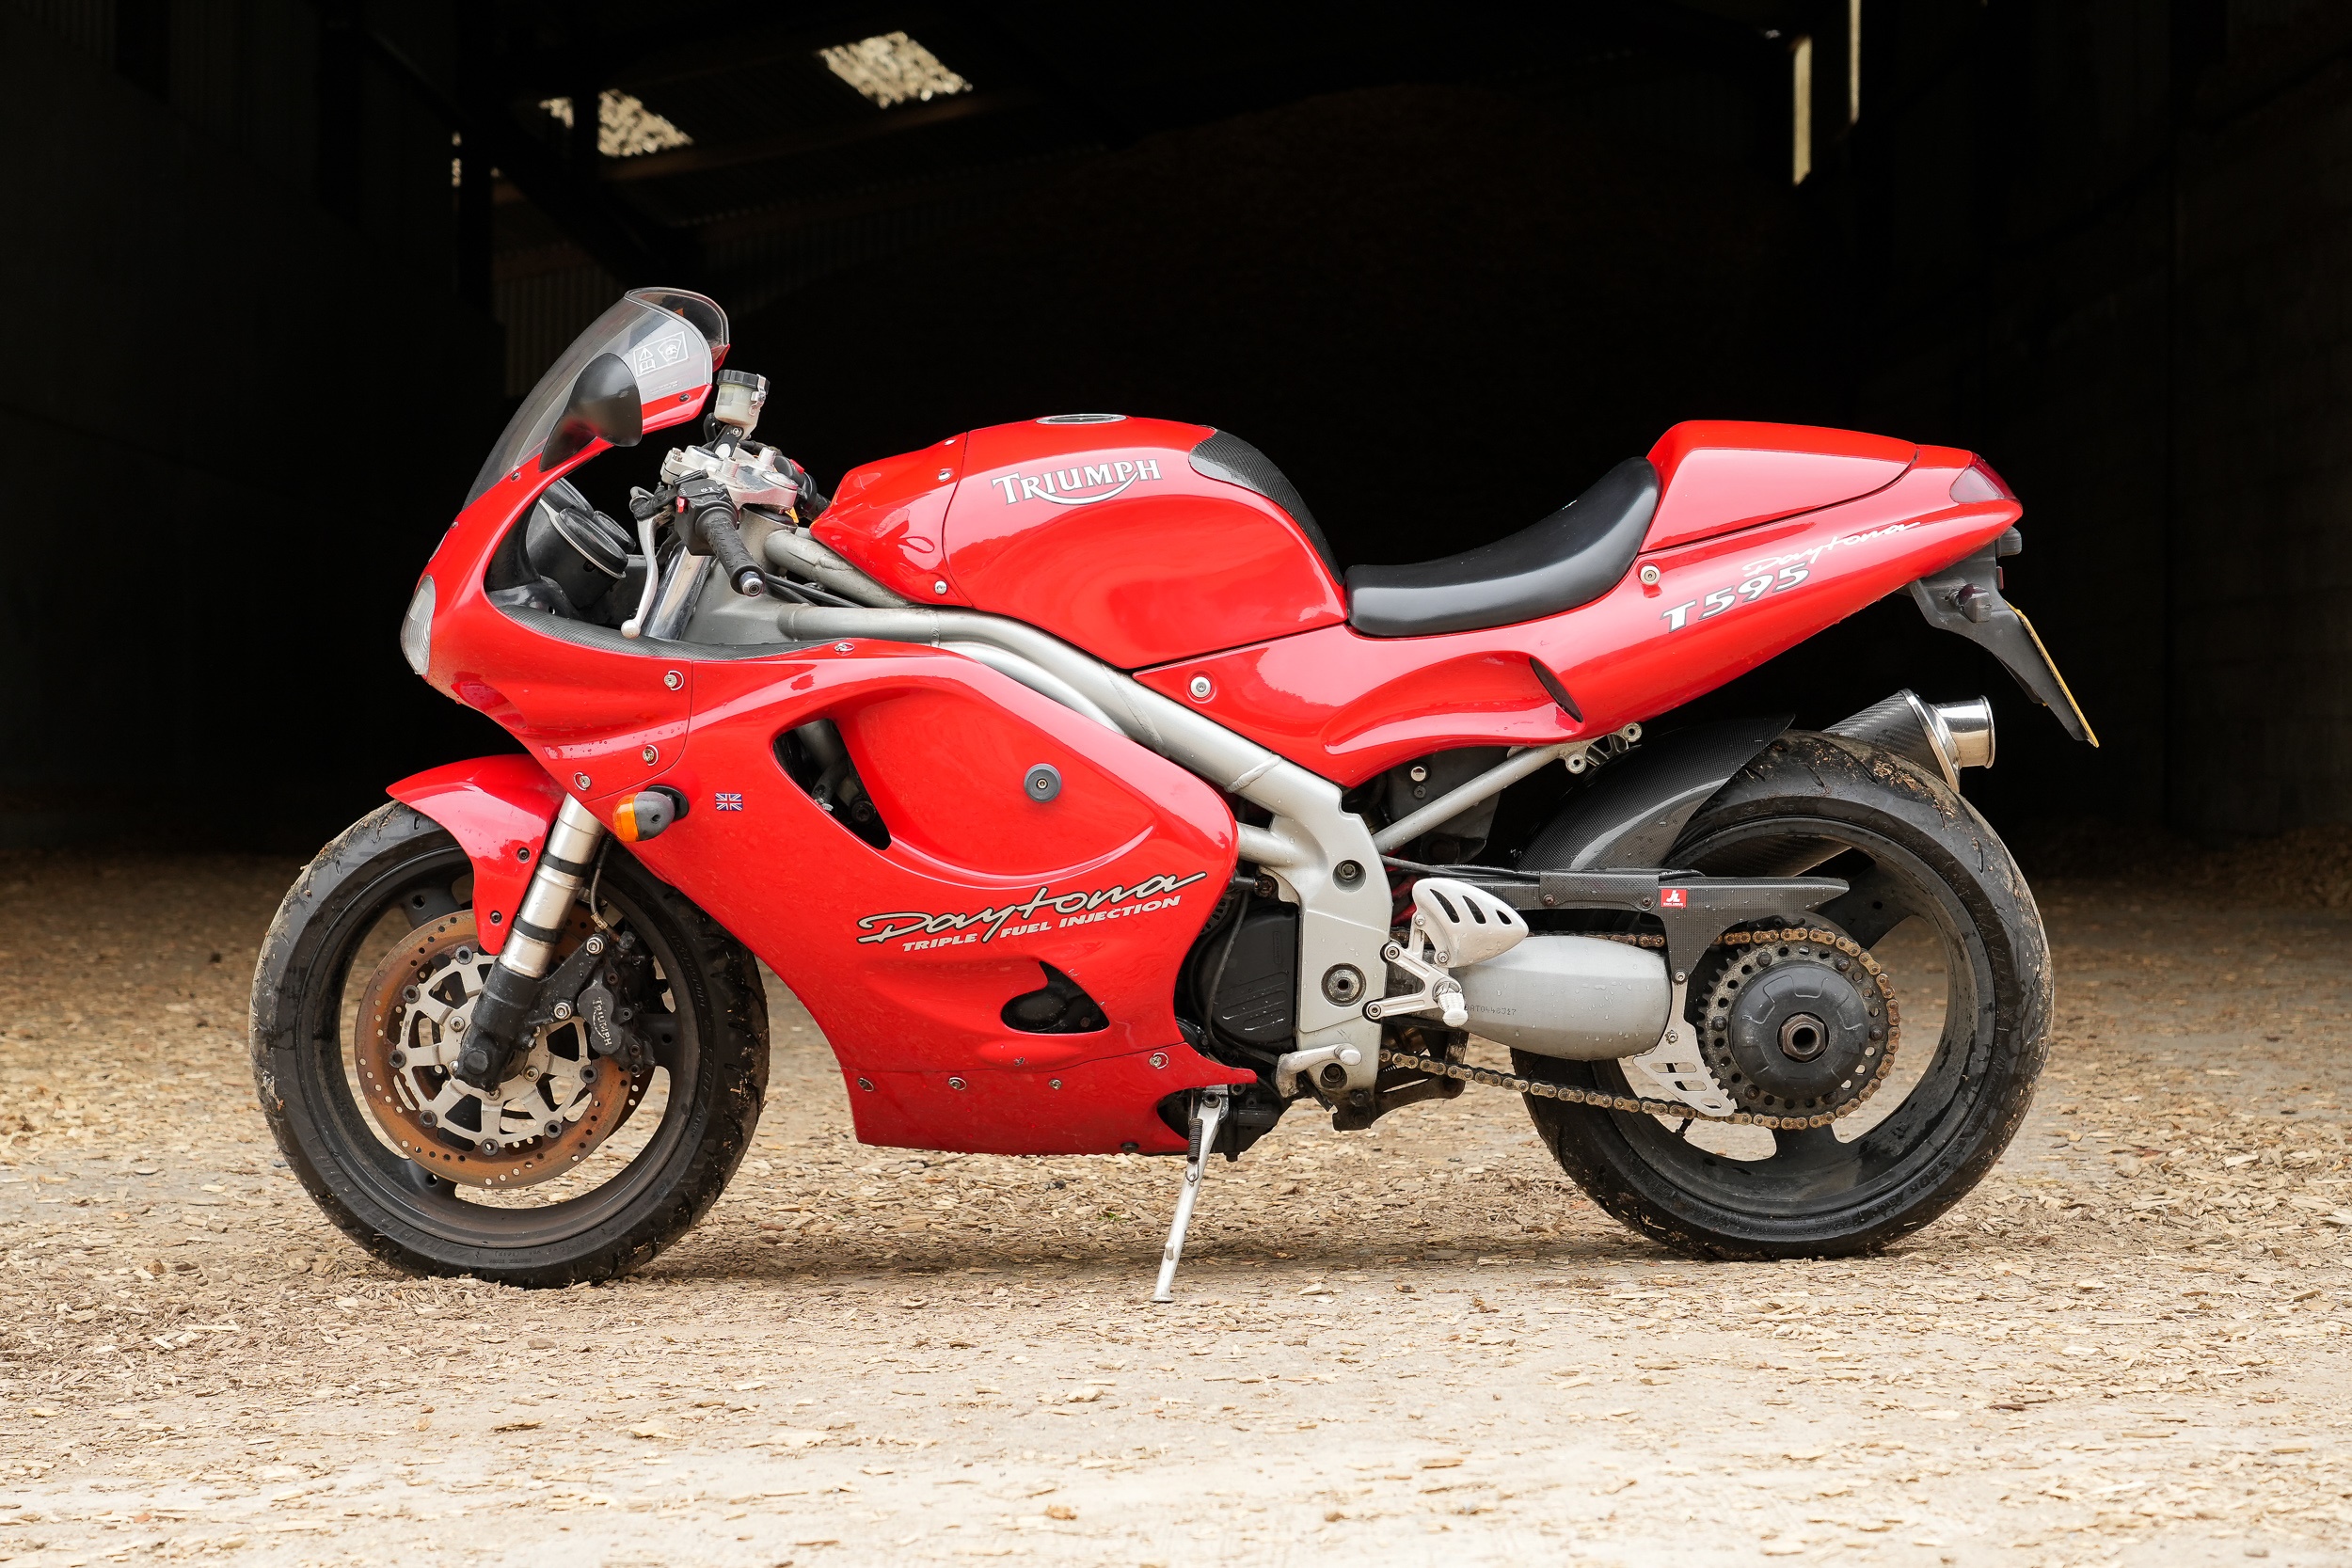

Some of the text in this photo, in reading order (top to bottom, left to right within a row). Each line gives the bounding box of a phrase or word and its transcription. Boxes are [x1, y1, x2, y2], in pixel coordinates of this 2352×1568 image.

[991, 459, 1163, 505] TRIUMPH
[1741, 521, 1921, 578] Daytona
[856, 871, 1207, 944] Daytona
[902, 895, 1181, 952] TRIPLE FUEL INJECTION
[592, 997, 612, 1047] TRIUMPH
